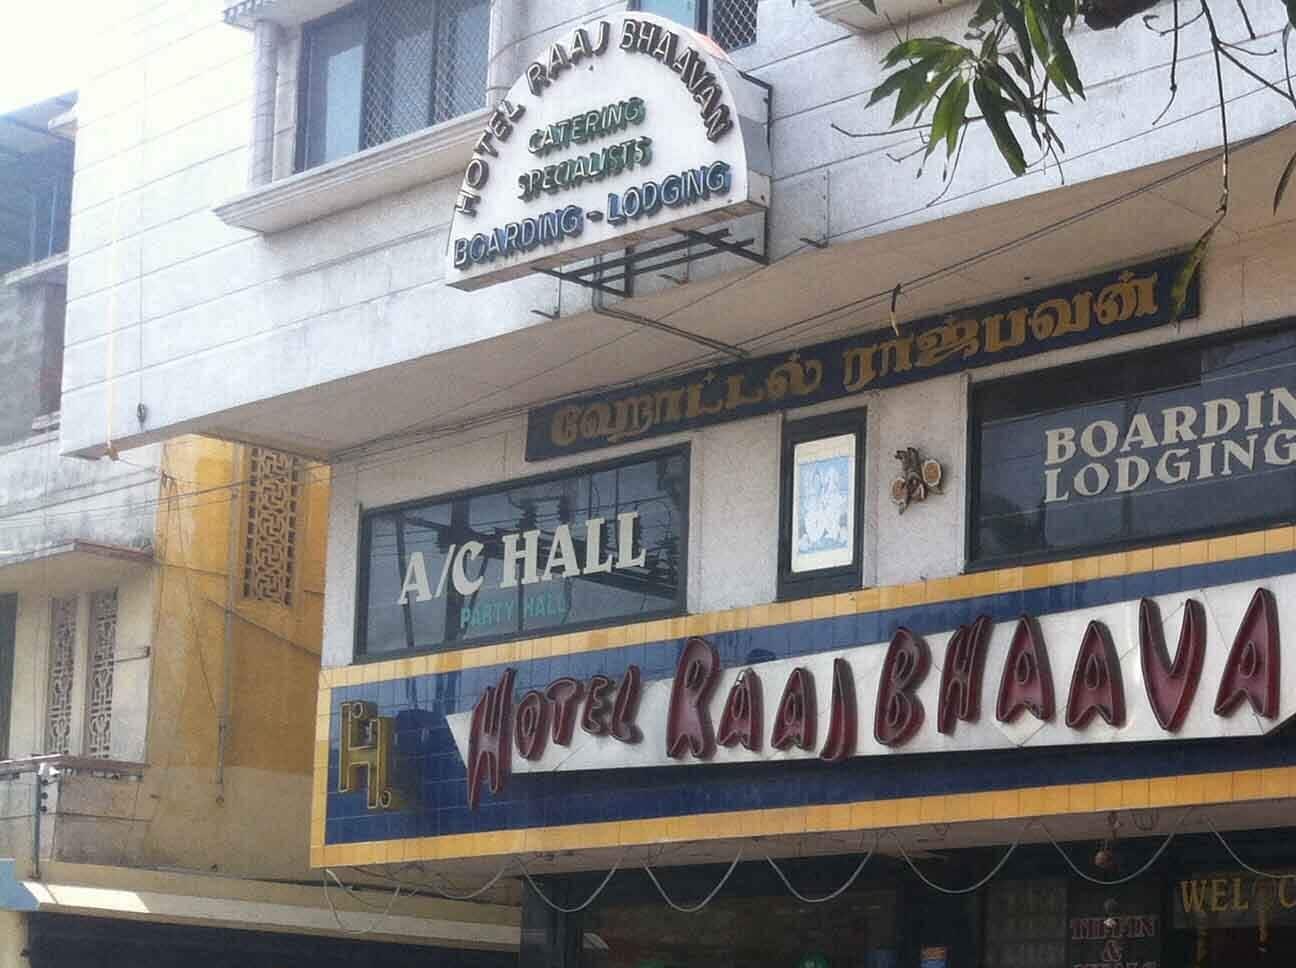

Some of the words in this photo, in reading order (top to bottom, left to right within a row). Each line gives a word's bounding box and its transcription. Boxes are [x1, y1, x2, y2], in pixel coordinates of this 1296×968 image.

[455, 99, 526, 217] HOTEL
[525, 20, 611, 96] RAAJ
[619, 17, 735, 143] BHAAVAN
[527, 96, 648, 155] CATERING
[453, 204, 586, 270] BOARDING
[606, 160, 731, 226] LODGING
[517, 136, 653, 200] SPECIALISTS
[398, 541, 485, 605] A/C
[499, 511, 647, 588] HALL
[459, 600, 514, 628] PARTY
[526, 592, 570, 618] HALL
[467, 664, 643, 811] HOTEL
[666, 636, 859, 762] RAAJ
